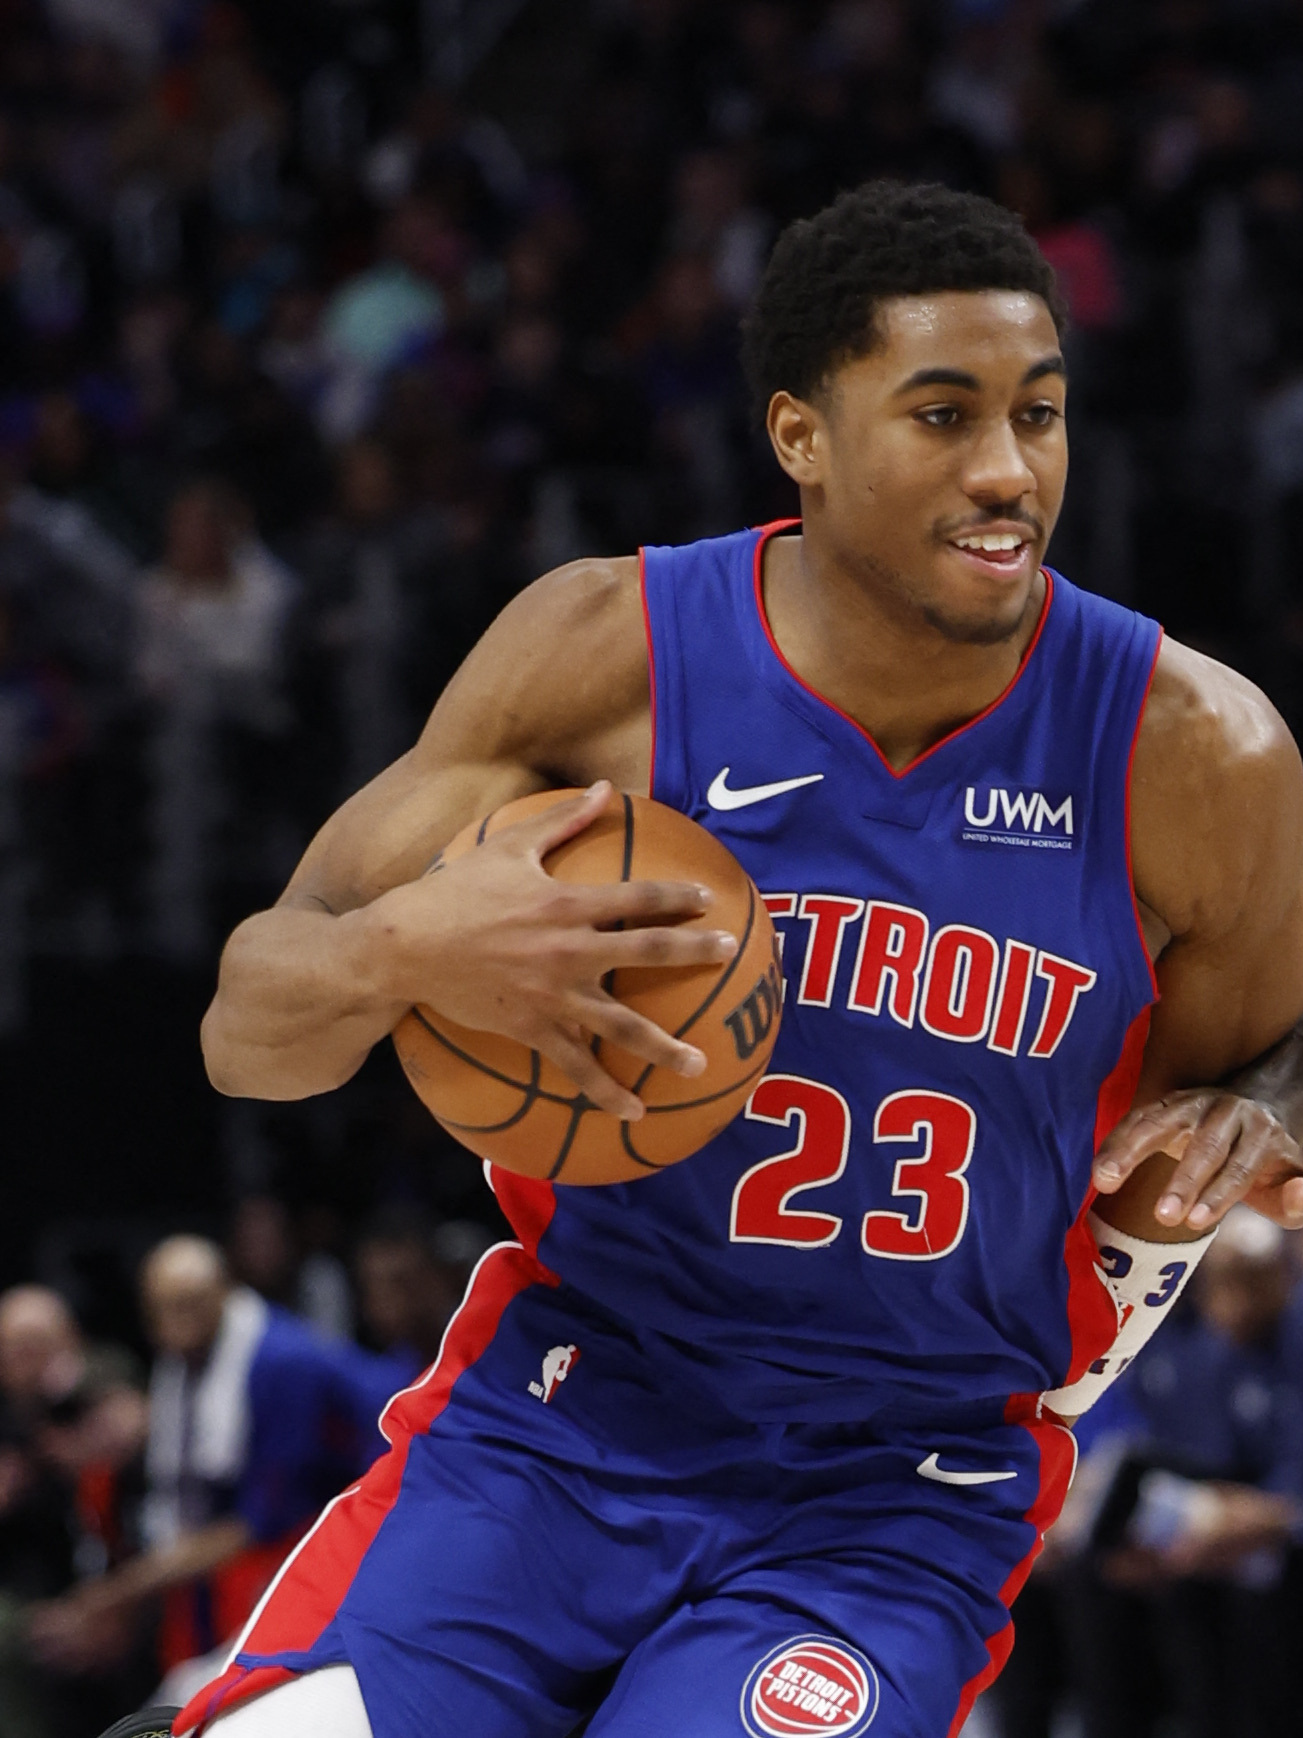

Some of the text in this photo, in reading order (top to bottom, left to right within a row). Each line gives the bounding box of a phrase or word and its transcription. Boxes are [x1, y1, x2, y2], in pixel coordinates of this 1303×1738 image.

[965, 787, 1073, 834] UWM
[962, 833, 989, 842] UNITED
[1032, 840, 1072, 849] MORTGAGE
[757, 892, 1097, 1060] TROIT
[730, 1074, 977, 1261] 23
[765, 1677, 842, 1722] PISTONS
[778, 1660, 854, 1707] DETROIT
